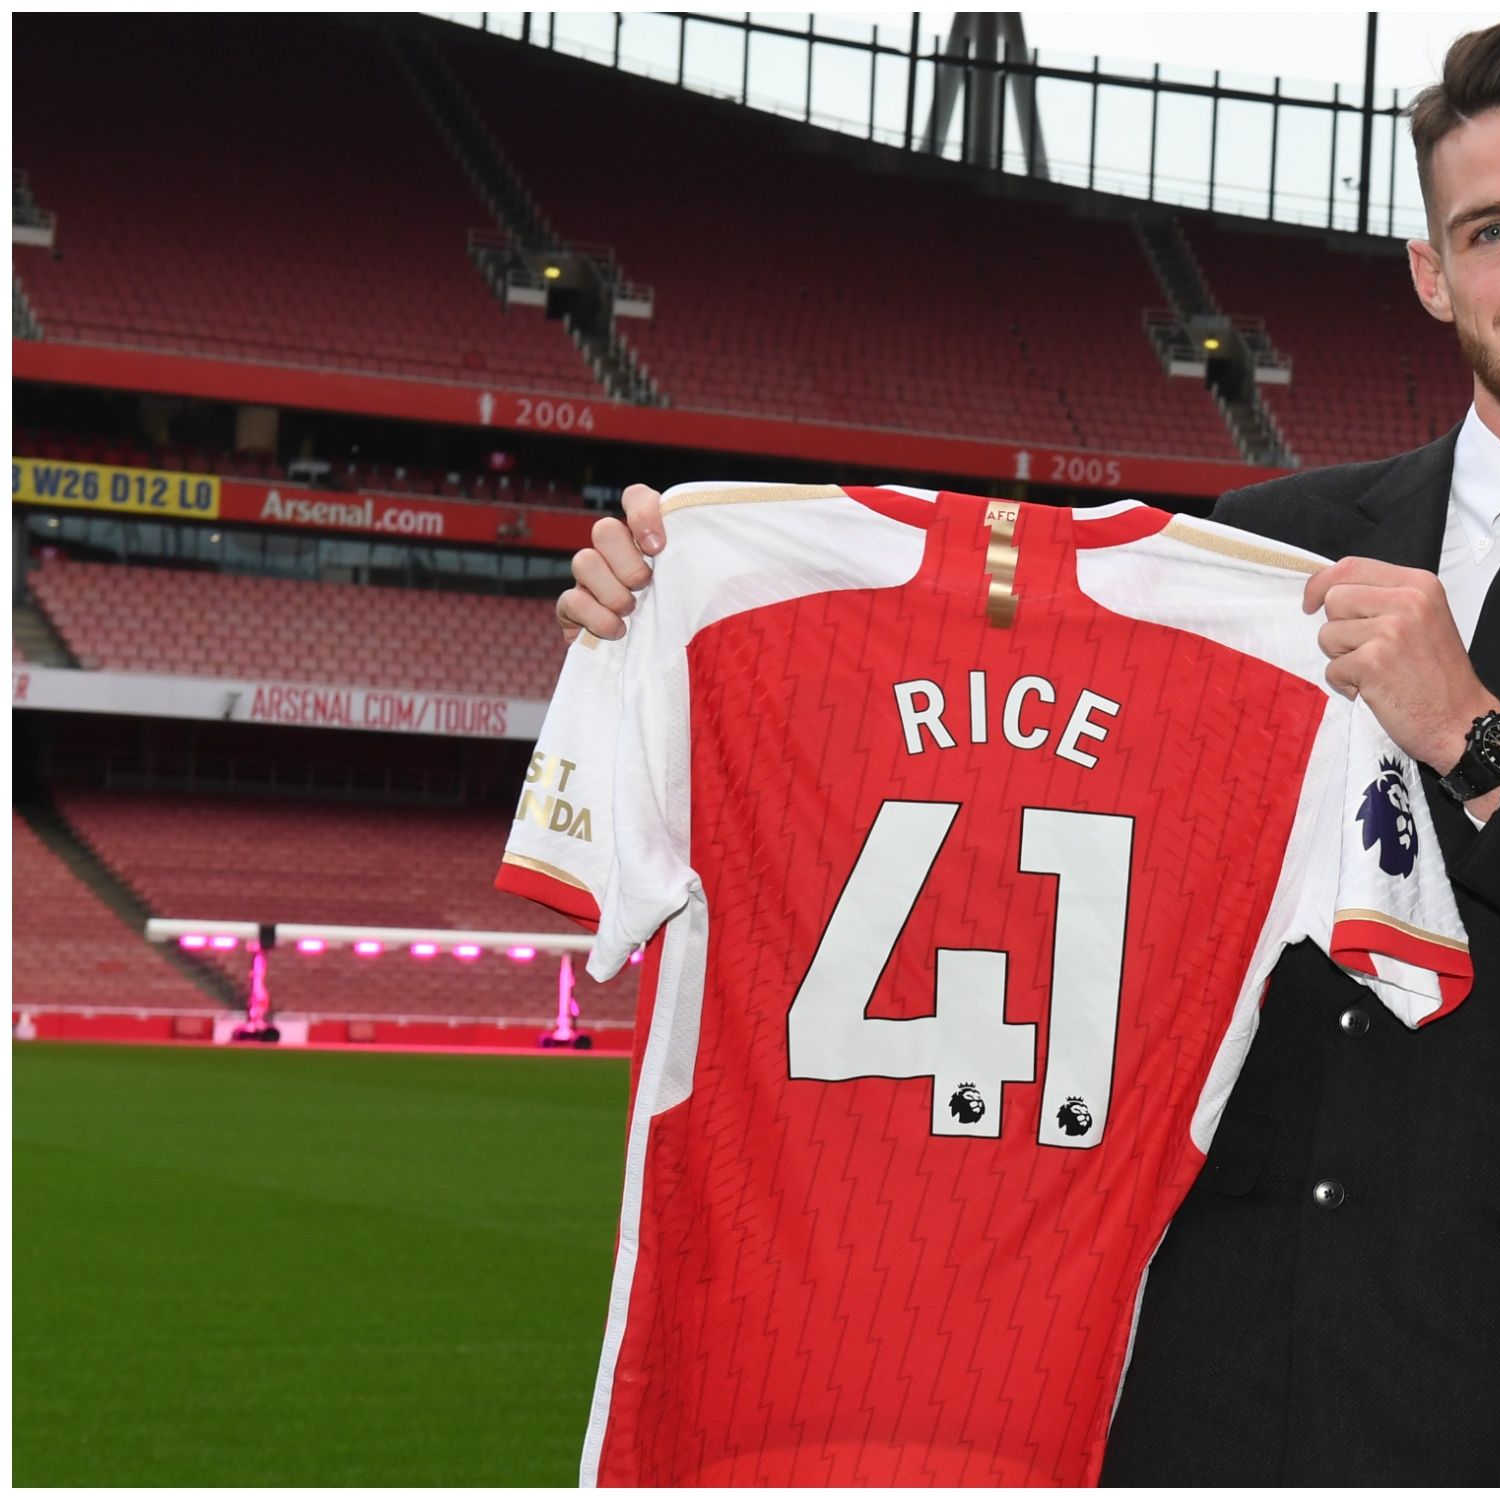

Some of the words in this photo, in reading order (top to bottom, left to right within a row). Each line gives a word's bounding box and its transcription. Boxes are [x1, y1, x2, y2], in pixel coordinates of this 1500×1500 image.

[515, 398, 595, 432] 2004
[32, 465, 99, 501] W26
[111, 473, 169, 508] D12
[1050, 455, 1122, 487] 2005
[261, 489, 444, 536] Arsenal.com
[986, 510, 1017, 523] AFC
[251, 684, 508, 737] ARSENAL.COM/TOURS
[892, 669, 1121, 769] RICE
[786, 798, 1137, 1151] 41
